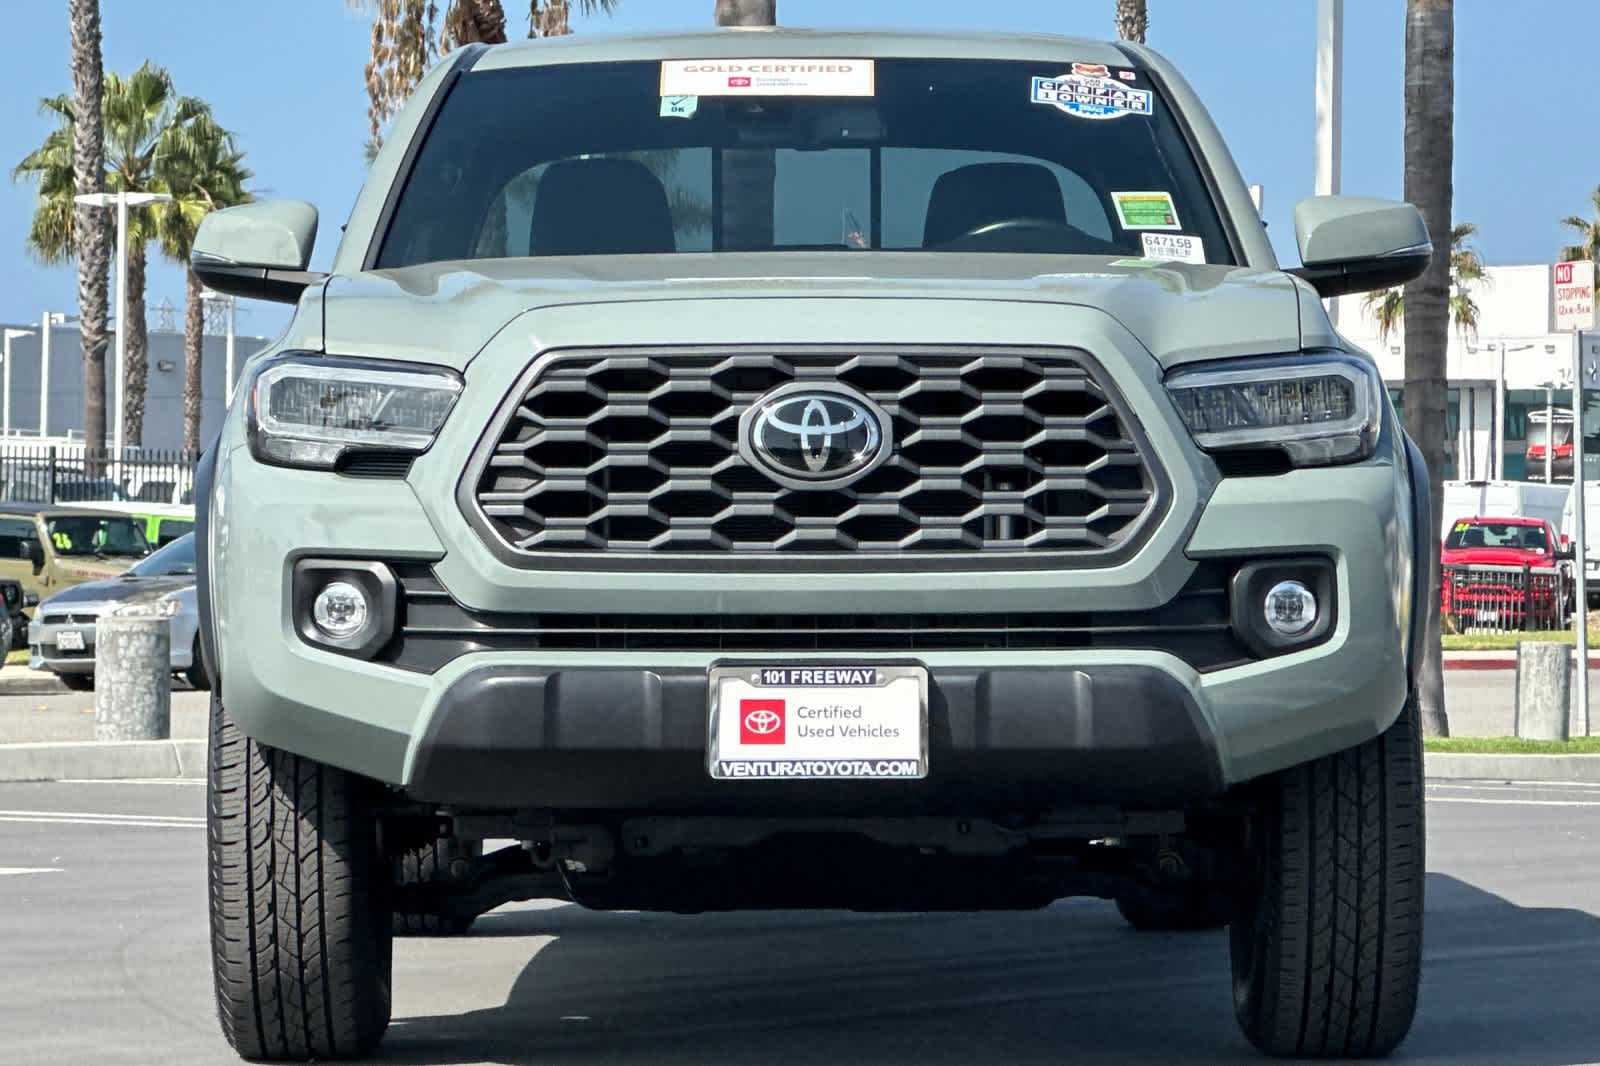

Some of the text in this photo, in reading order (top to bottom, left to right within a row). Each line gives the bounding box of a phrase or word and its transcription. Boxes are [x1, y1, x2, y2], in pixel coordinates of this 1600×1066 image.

[683, 65, 853, 73] GOLD CERTIFIED
[1041, 81, 1145, 100] CARFAX
[1557, 266, 1570, 282] NO
[1558, 286, 1591, 301] STOPPING
[763, 670, 873, 684] 101 FREEWAY
[796, 706, 863, 720] Certified
[797, 724, 900, 738] Used Vehicles
[721, 761, 917, 776] VENTURATOYOTA.COM
